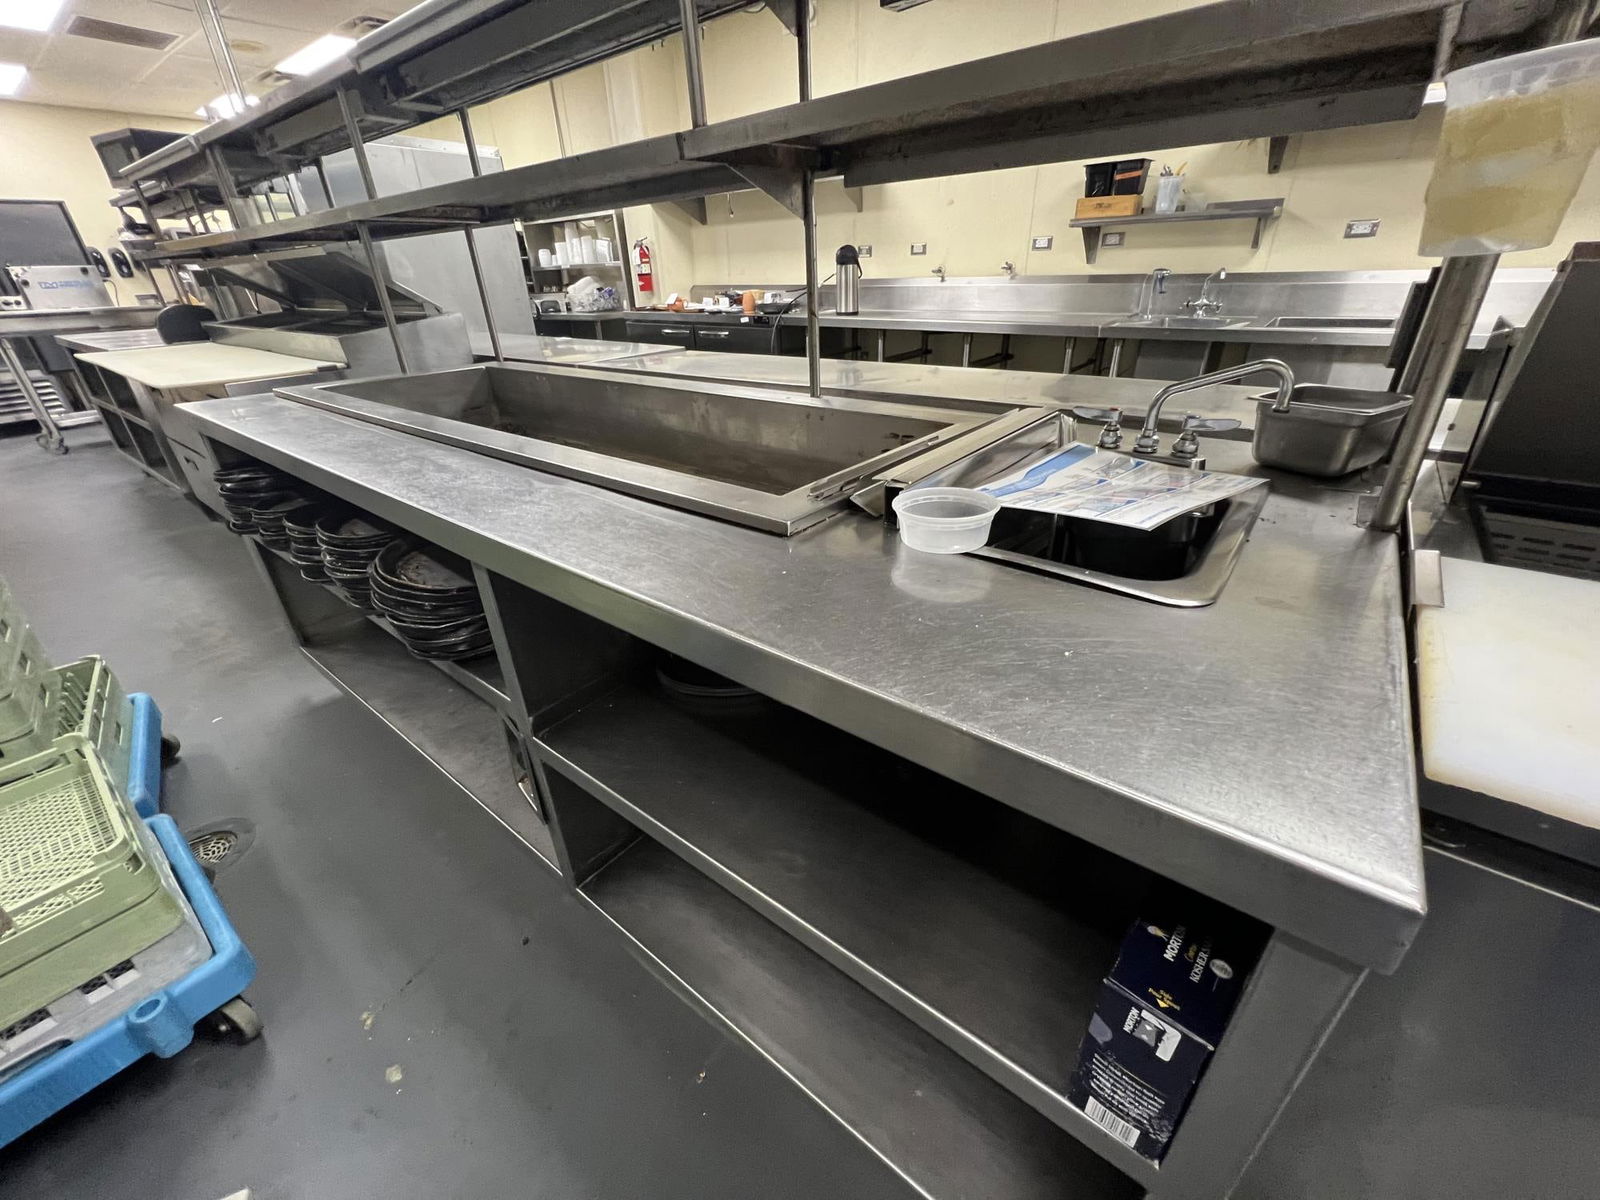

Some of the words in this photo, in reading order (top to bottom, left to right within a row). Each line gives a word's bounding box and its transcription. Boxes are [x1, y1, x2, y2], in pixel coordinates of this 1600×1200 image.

[1163, 924, 1187, 962] MORTON
[1189, 951, 1209, 983] KOSHER
[1123, 1006, 1139, 1033] MORTON
